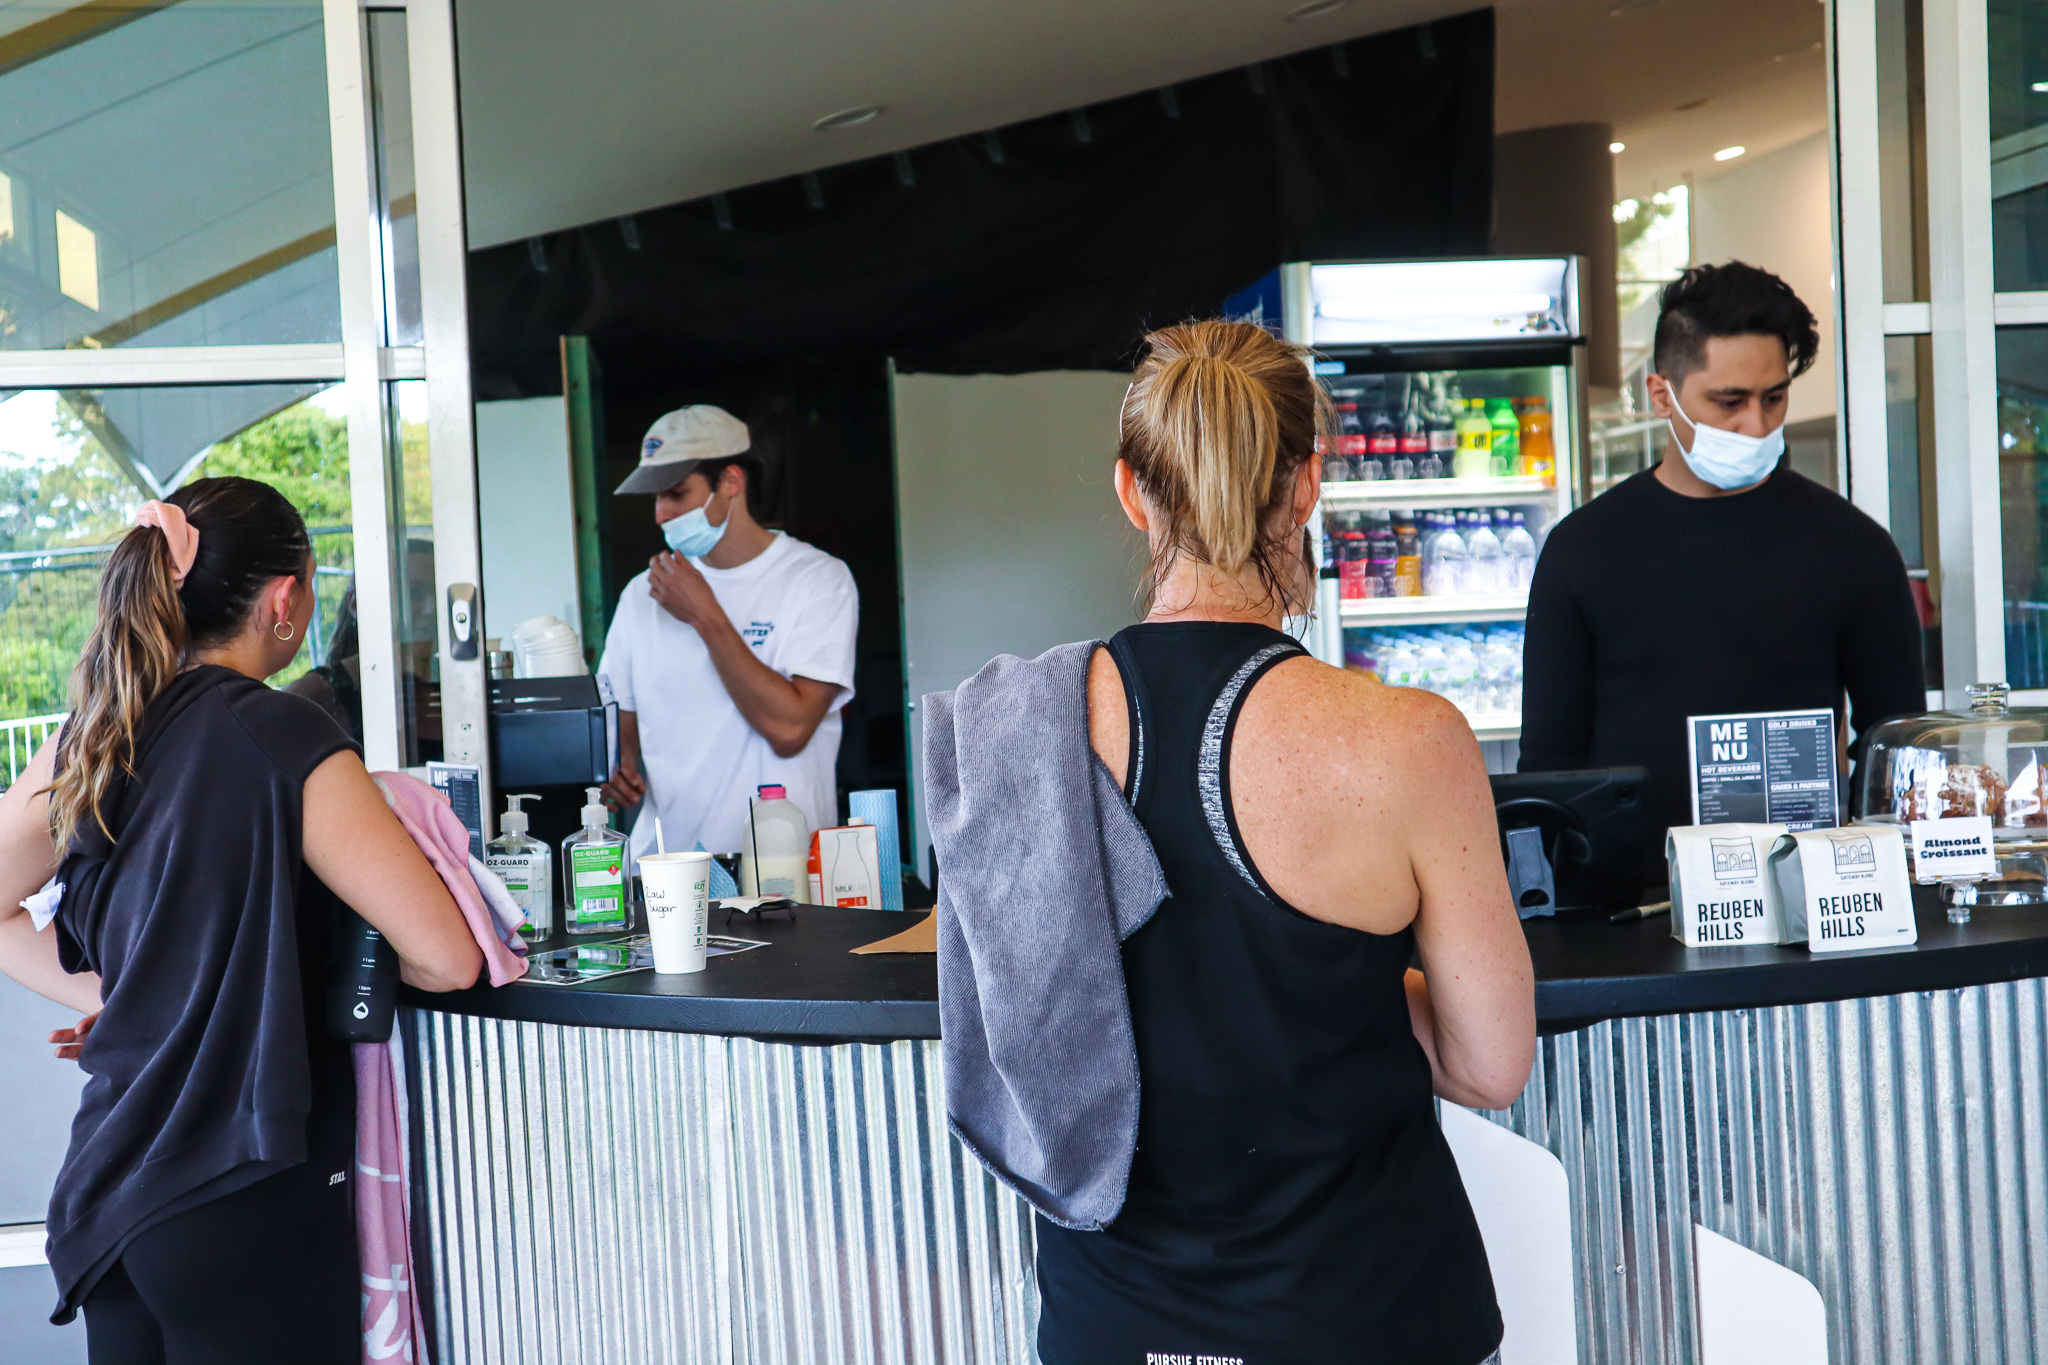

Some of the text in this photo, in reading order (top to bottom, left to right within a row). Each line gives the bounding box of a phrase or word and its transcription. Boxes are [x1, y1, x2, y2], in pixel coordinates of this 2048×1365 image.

[1767, 719, 1817, 729] COLD DRINKS
[1710, 721, 1748, 742] ME
[1712, 741, 1748, 762] NU
[1718, 764, 1761, 773] BEVERAGES
[434, 770, 449, 787] ME
[1770, 781, 1830, 791] CAKES & PASTRIES
[1787, 822, 1813, 831] CREAM
[1924, 836, 1981, 848] Almond
[574, 849, 610, 857] OZ-GUARD
[1920, 847, 1987, 859] Croissant
[648, 900, 677, 919] Sugar
[1697, 899, 1764, 923] REUBEN
[1818, 892, 1883, 917] REUBEN
[1697, 921, 1744, 942] HILLS
[1820, 916, 1865, 939] HILLS
[1146, 1353, 1244, 1365] PURSUE FITNESS
